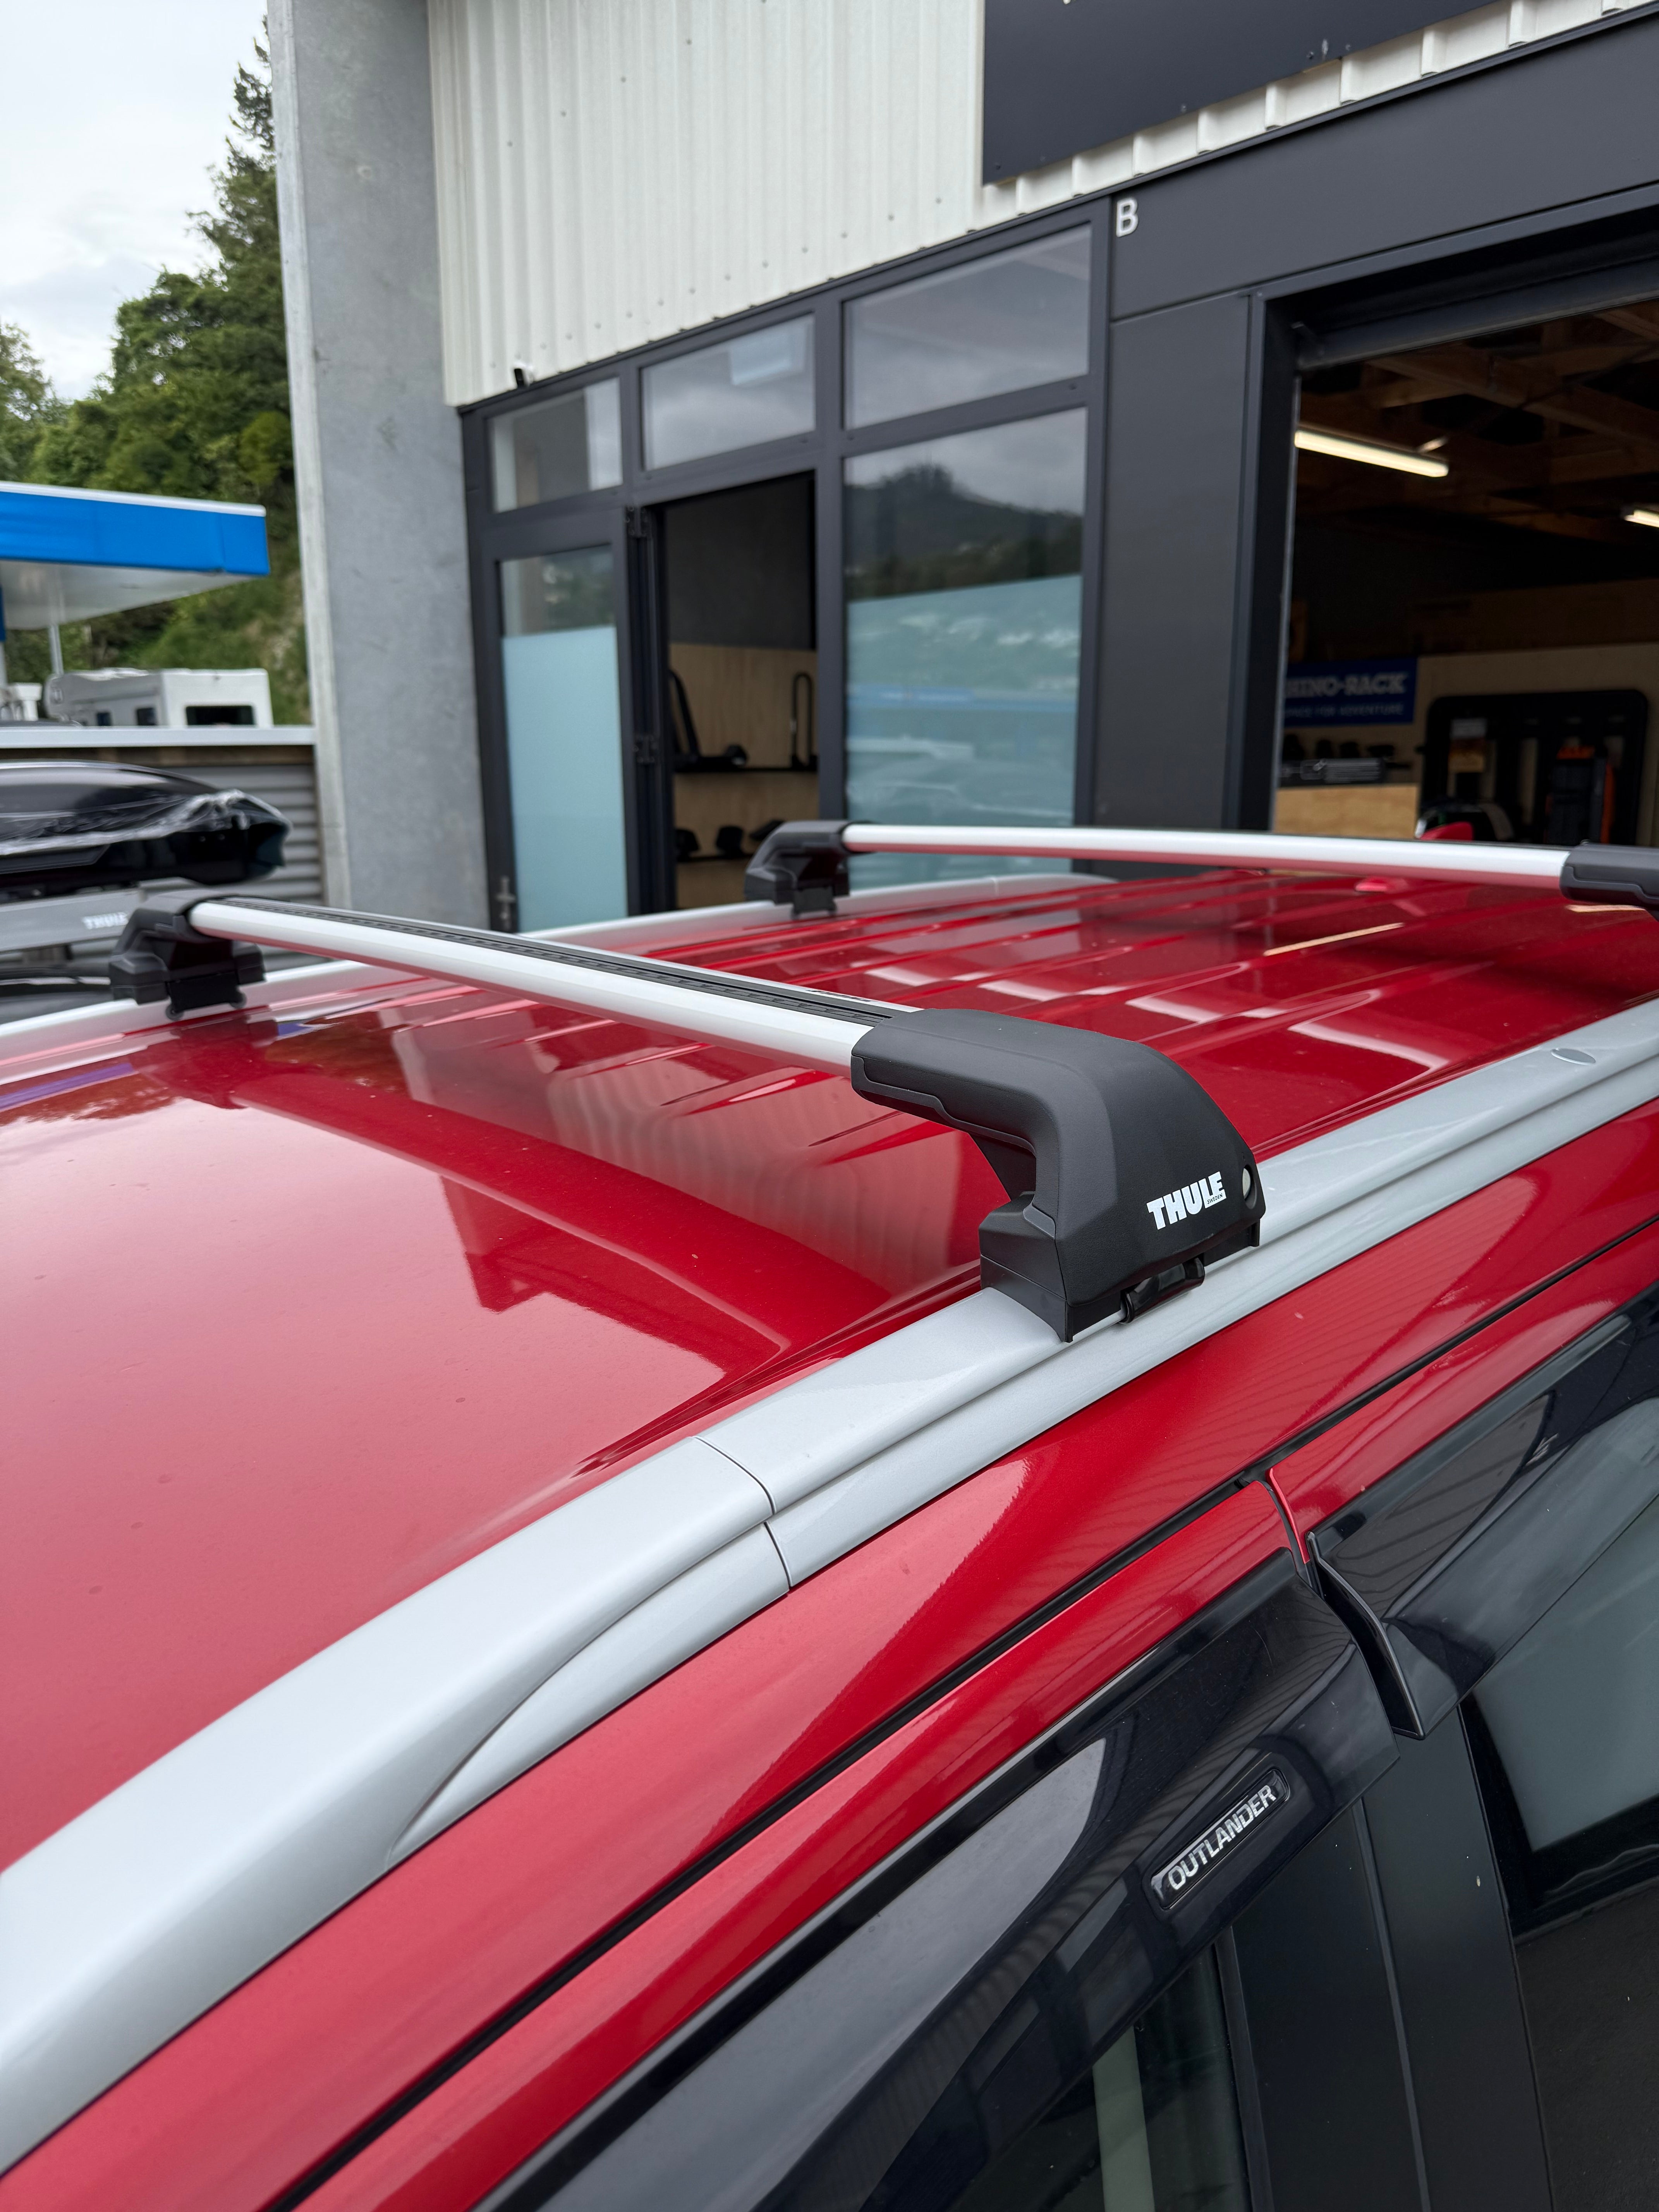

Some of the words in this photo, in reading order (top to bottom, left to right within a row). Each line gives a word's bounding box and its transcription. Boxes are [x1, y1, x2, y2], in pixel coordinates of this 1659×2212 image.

[1116, 198, 1138, 237] B
[1286, 672, 1407, 698] HINO-RACK
[82, 912, 128, 929] THULE
[1147, 1171, 1226, 1230] THULE
[1207, 1193, 1223, 1205] SWEDEN
[1168, 1785, 1276, 1890] OUTLANDER
